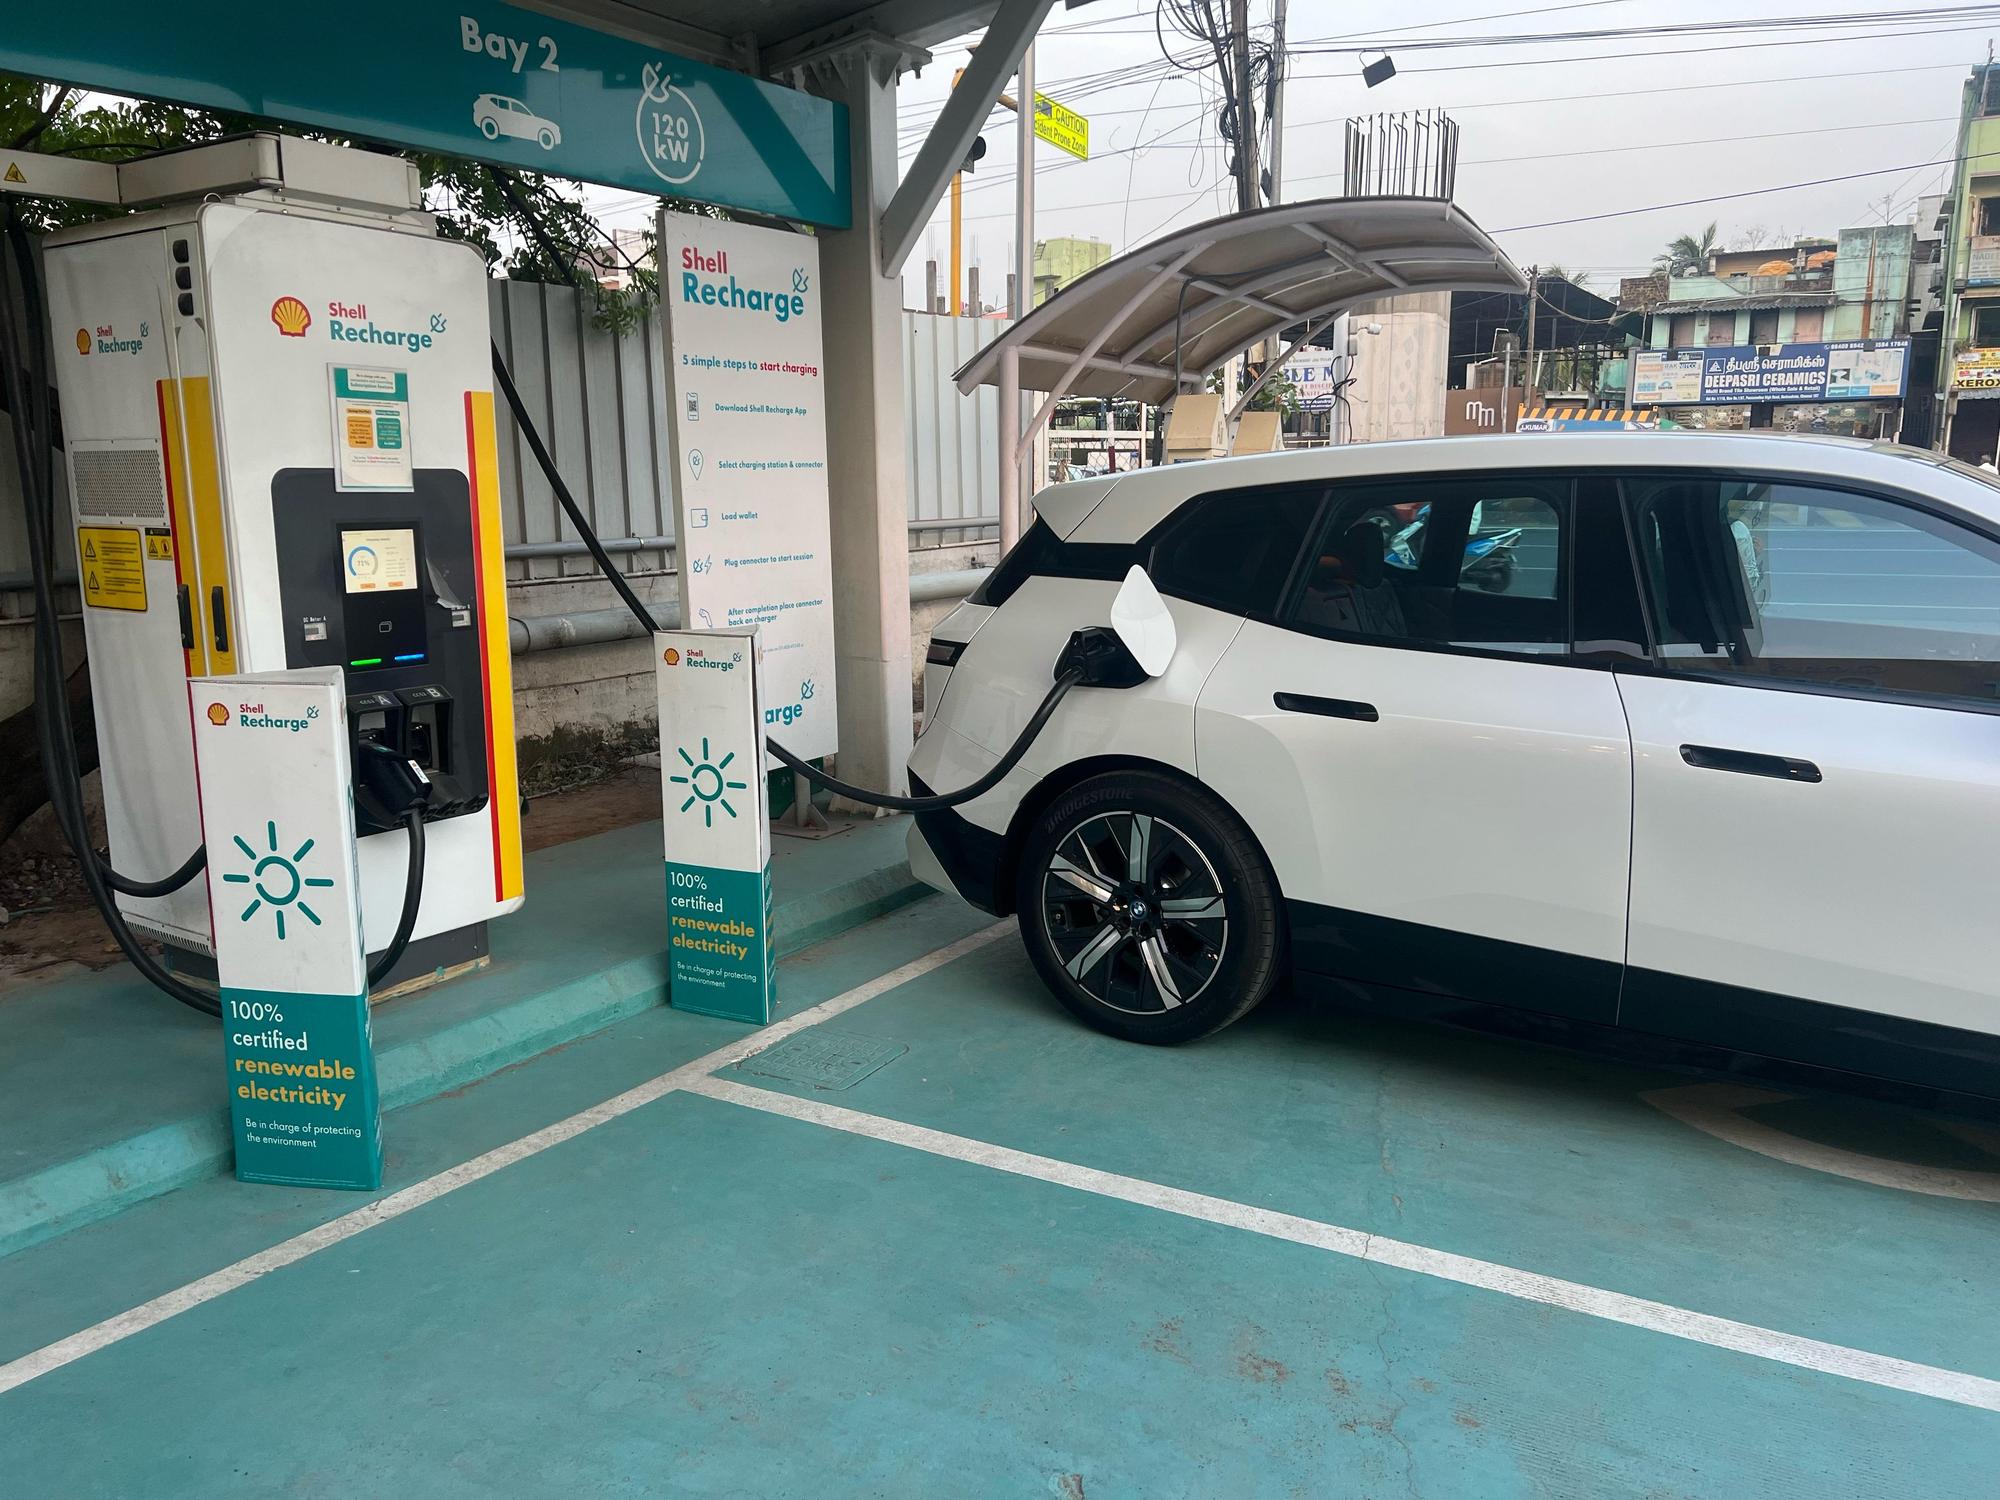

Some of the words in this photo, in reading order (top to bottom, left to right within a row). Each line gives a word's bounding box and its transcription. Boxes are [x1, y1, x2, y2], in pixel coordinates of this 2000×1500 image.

[460, 15, 529, 73] Bay
[538, 36, 560, 73] 2
[651, 112, 689, 139] 120
[1055, 107, 1086, 135] CAUTION
[1034, 120, 1053, 139] cident
[1053, 128, 1072, 148] Prone
[1071, 136, 1086, 156] Zone
[654, 134, 689, 163] kW
[681, 247, 728, 274] Shell
[682, 271, 805, 322] Recharge
[329, 302, 367, 320] Shell
[96, 325, 113, 338] Shell
[329, 320, 432, 353] Recharge
[97, 337, 143, 356] Recharge
[682, 354, 689, 366] 5
[690, 354, 721, 369] simple
[723, 357, 747, 373] steps
[748, 360, 758, 370] to
[760, 361, 780, 372] start
[782, 362, 818, 377] charging
[1704, 373, 1760, 388] DEEPASRI
[1762, 371, 1826, 386] CERAMICS
[1957, 379, 2000, 387] XEROX
[715, 403, 748, 413] Download
[749, 404, 765, 413] Shell
[765, 405, 794, 415] Recharge
[794, 406, 807, 416] App
[718, 460, 738, 469] Select
[739, 461, 766, 471] charging
[767, 461, 788, 469] station
[795, 461, 823, 469] connector
[721, 512, 736, 520] Load
[738, 511, 758, 520] wallet
[724, 559, 738, 568] Plug
[739, 556, 769, 565] connector
[770, 555, 777, 563] to
[778, 554, 792, 562] start
[793, 553, 814, 561] session
[728, 607, 743, 616] After
[744, 603, 779, 617] completion
[779, 601, 797, 612] place
[798, 598, 823, 608] connector
[728, 617, 743, 626] back
[754, 613, 777, 624] charger
[686, 649, 704, 657] Shell
[686, 657, 734, 671] Recharge
[378, 695, 392, 705] A
[427, 687, 441, 698] B
[239, 704, 264, 714] Shell
[765, 702, 803, 725] arge
[240, 714, 309, 732] Recharge
[1045, 786, 1136, 833] BRIDGESTONE
[670, 871, 708, 890] 100%
[671, 895, 723, 913] certified
[671, 915, 755, 937] renewable
[672, 933, 748, 960] electricity
[677, 961, 685, 969] Be
[686, 963, 692, 971] in
[692, 964, 715, 976] charge
[715, 968, 723, 976] of
[724, 970, 757, 983] protecting
[677, 973, 688, 981] the
[688, 975, 726, 988] environment
[230, 1000, 284, 1022] 100%
[232, 1029, 308, 1051] certified
[235, 1058, 356, 1080] renewable
[237, 1080, 346, 1111] electricity
[245, 1117, 257, 1128] Be
[259, 1120, 267, 1129] in
[269, 1120, 300, 1134] charge
[302, 1123, 312, 1133] of
[313, 1125, 361, 1138] protecting
[247, 1132, 261, 1143] the
[262, 1137, 317, 1148] environment
